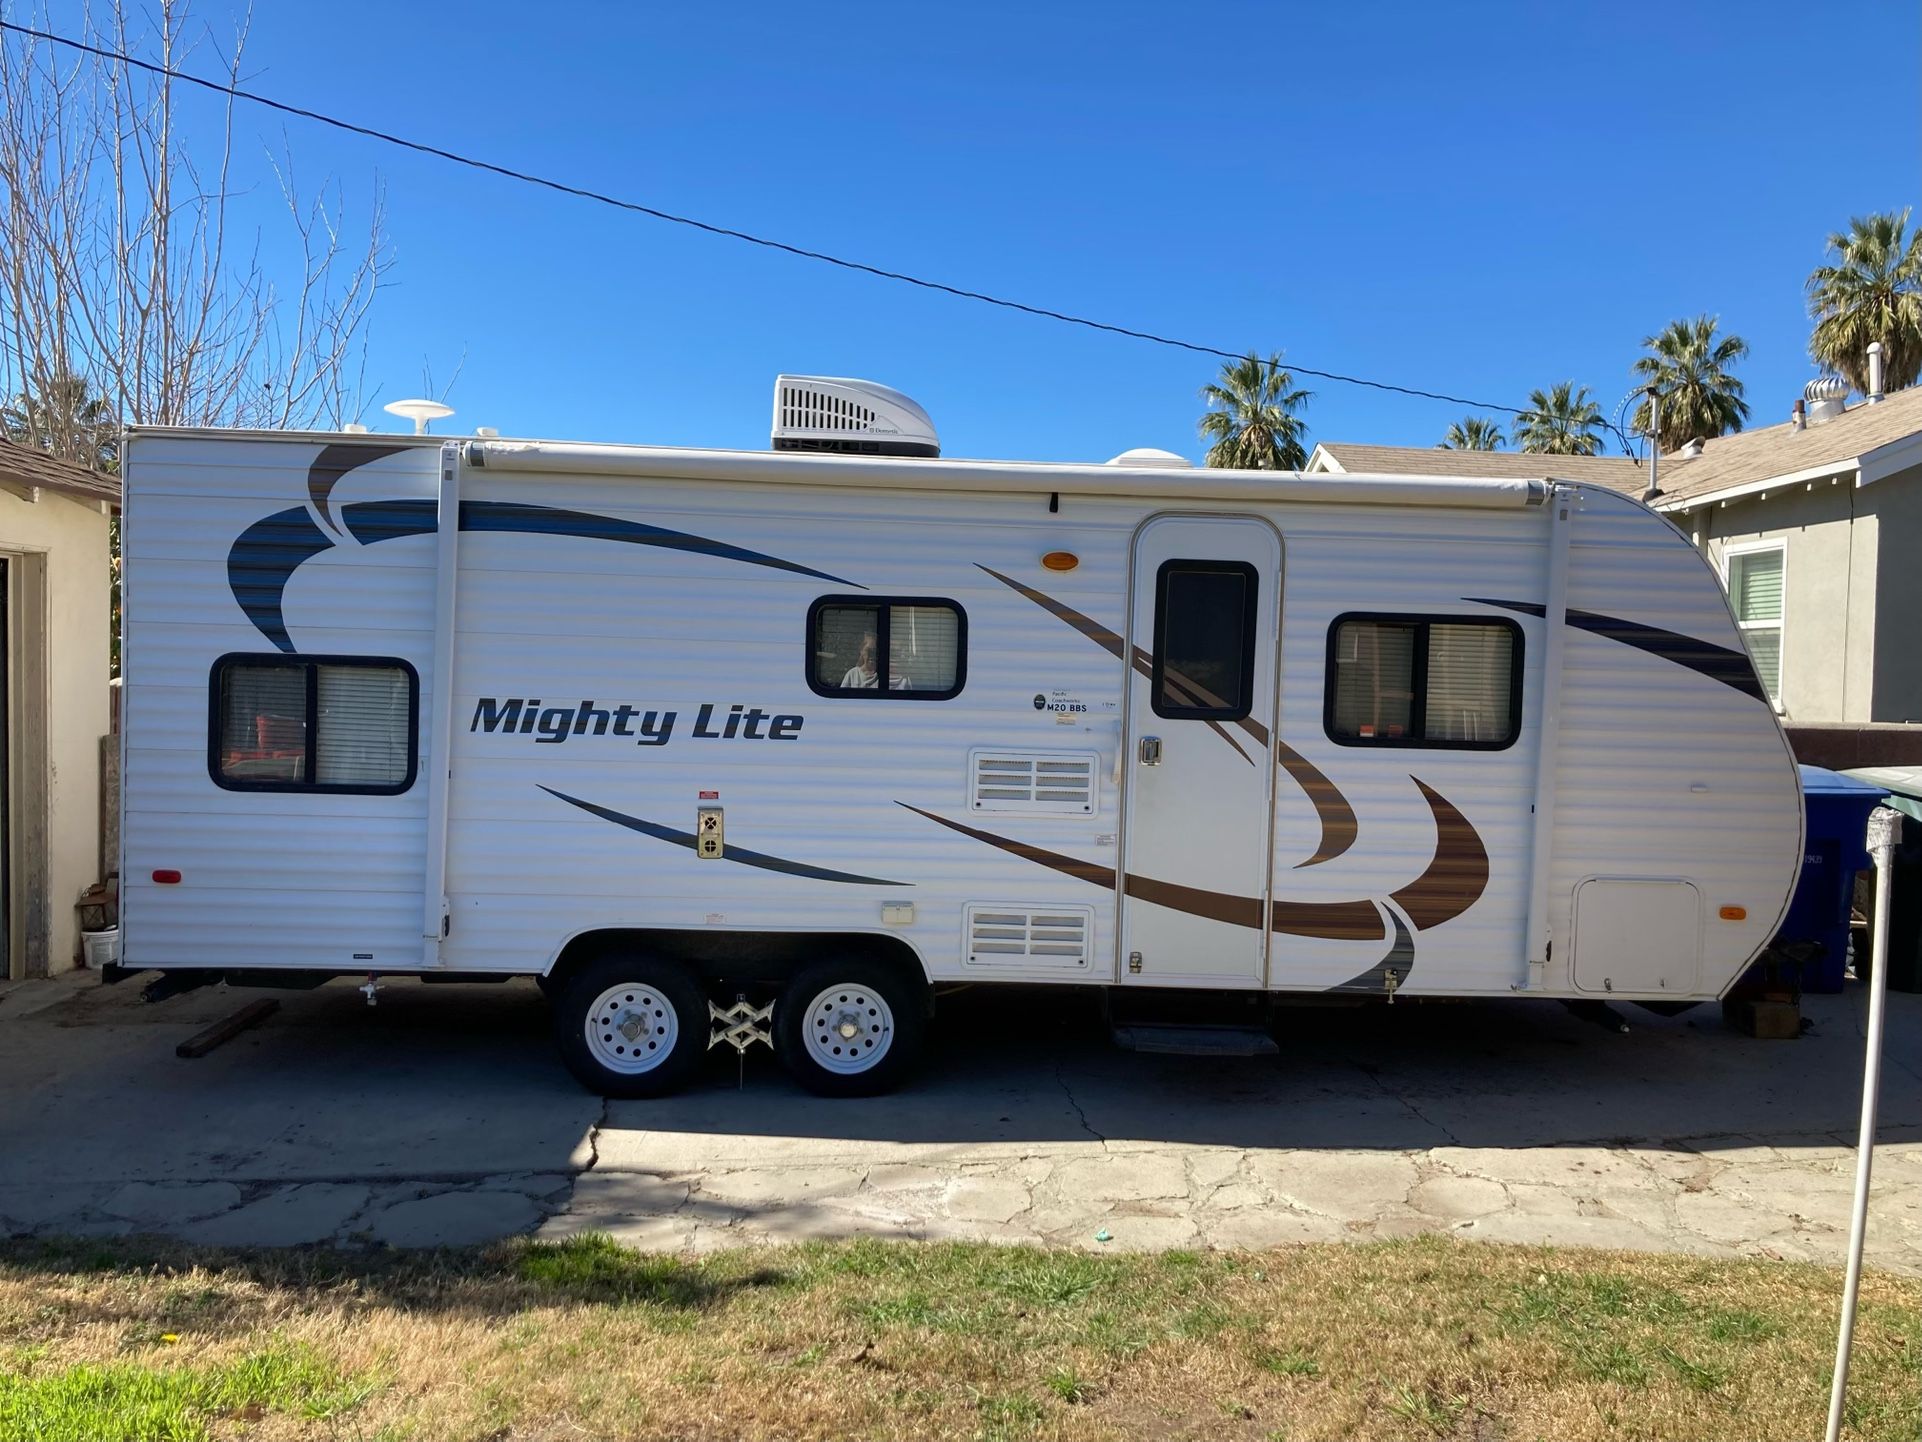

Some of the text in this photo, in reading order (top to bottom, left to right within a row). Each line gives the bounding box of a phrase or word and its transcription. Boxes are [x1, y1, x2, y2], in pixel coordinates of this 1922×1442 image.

[1047, 703, 1087, 712] M20 BBS
[470, 698, 804, 746] Mighty Lite
